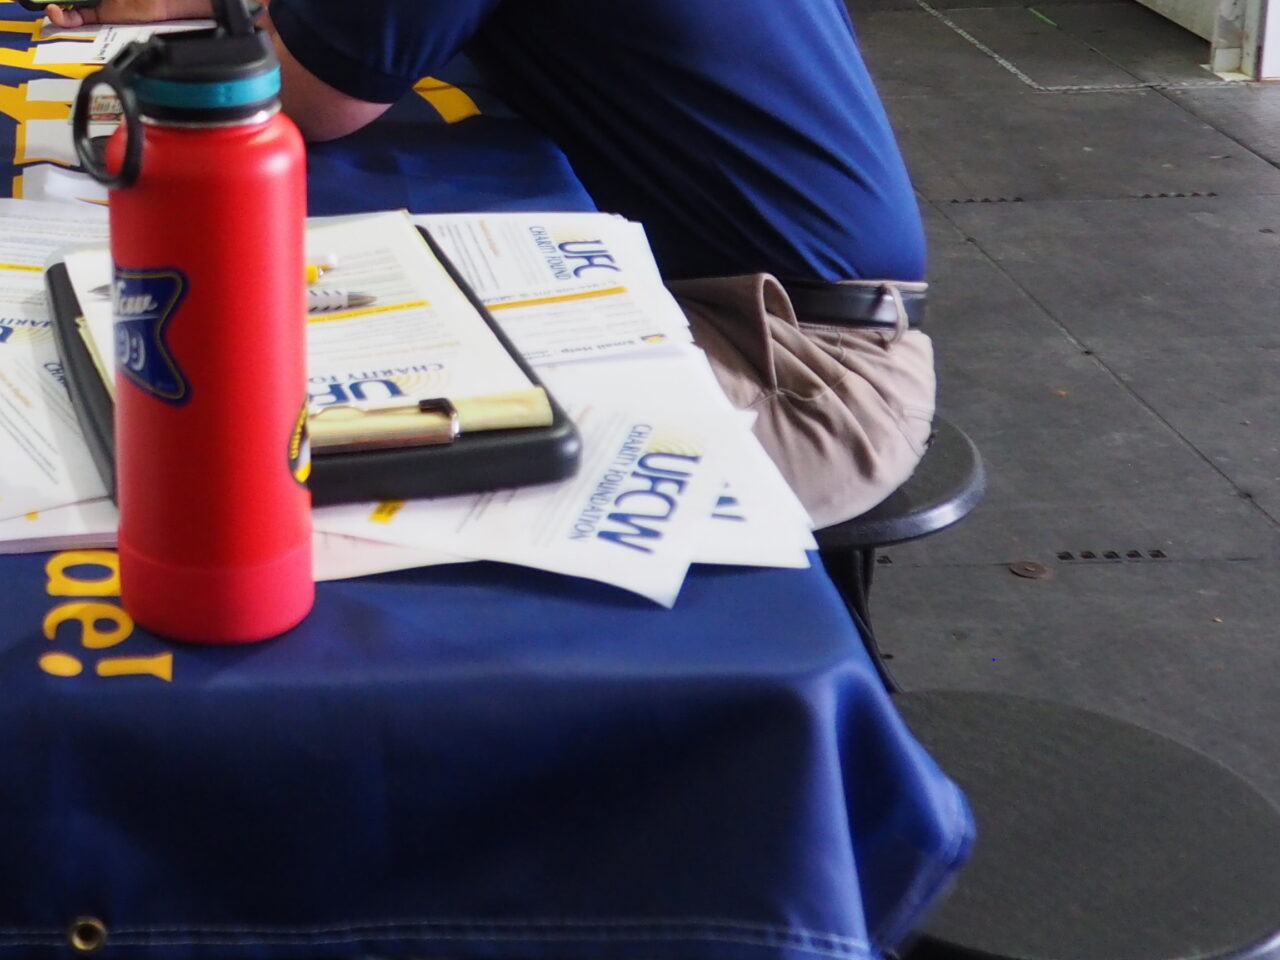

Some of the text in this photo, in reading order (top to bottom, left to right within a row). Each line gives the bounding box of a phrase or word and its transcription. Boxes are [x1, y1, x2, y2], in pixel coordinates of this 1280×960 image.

[529, 226, 556, 254] CHARITY
[348, 363, 445, 381] CHARITY
[569, 424, 652, 539] CHARITY FOUNDATION
[597, 451, 701, 554] UFCW
